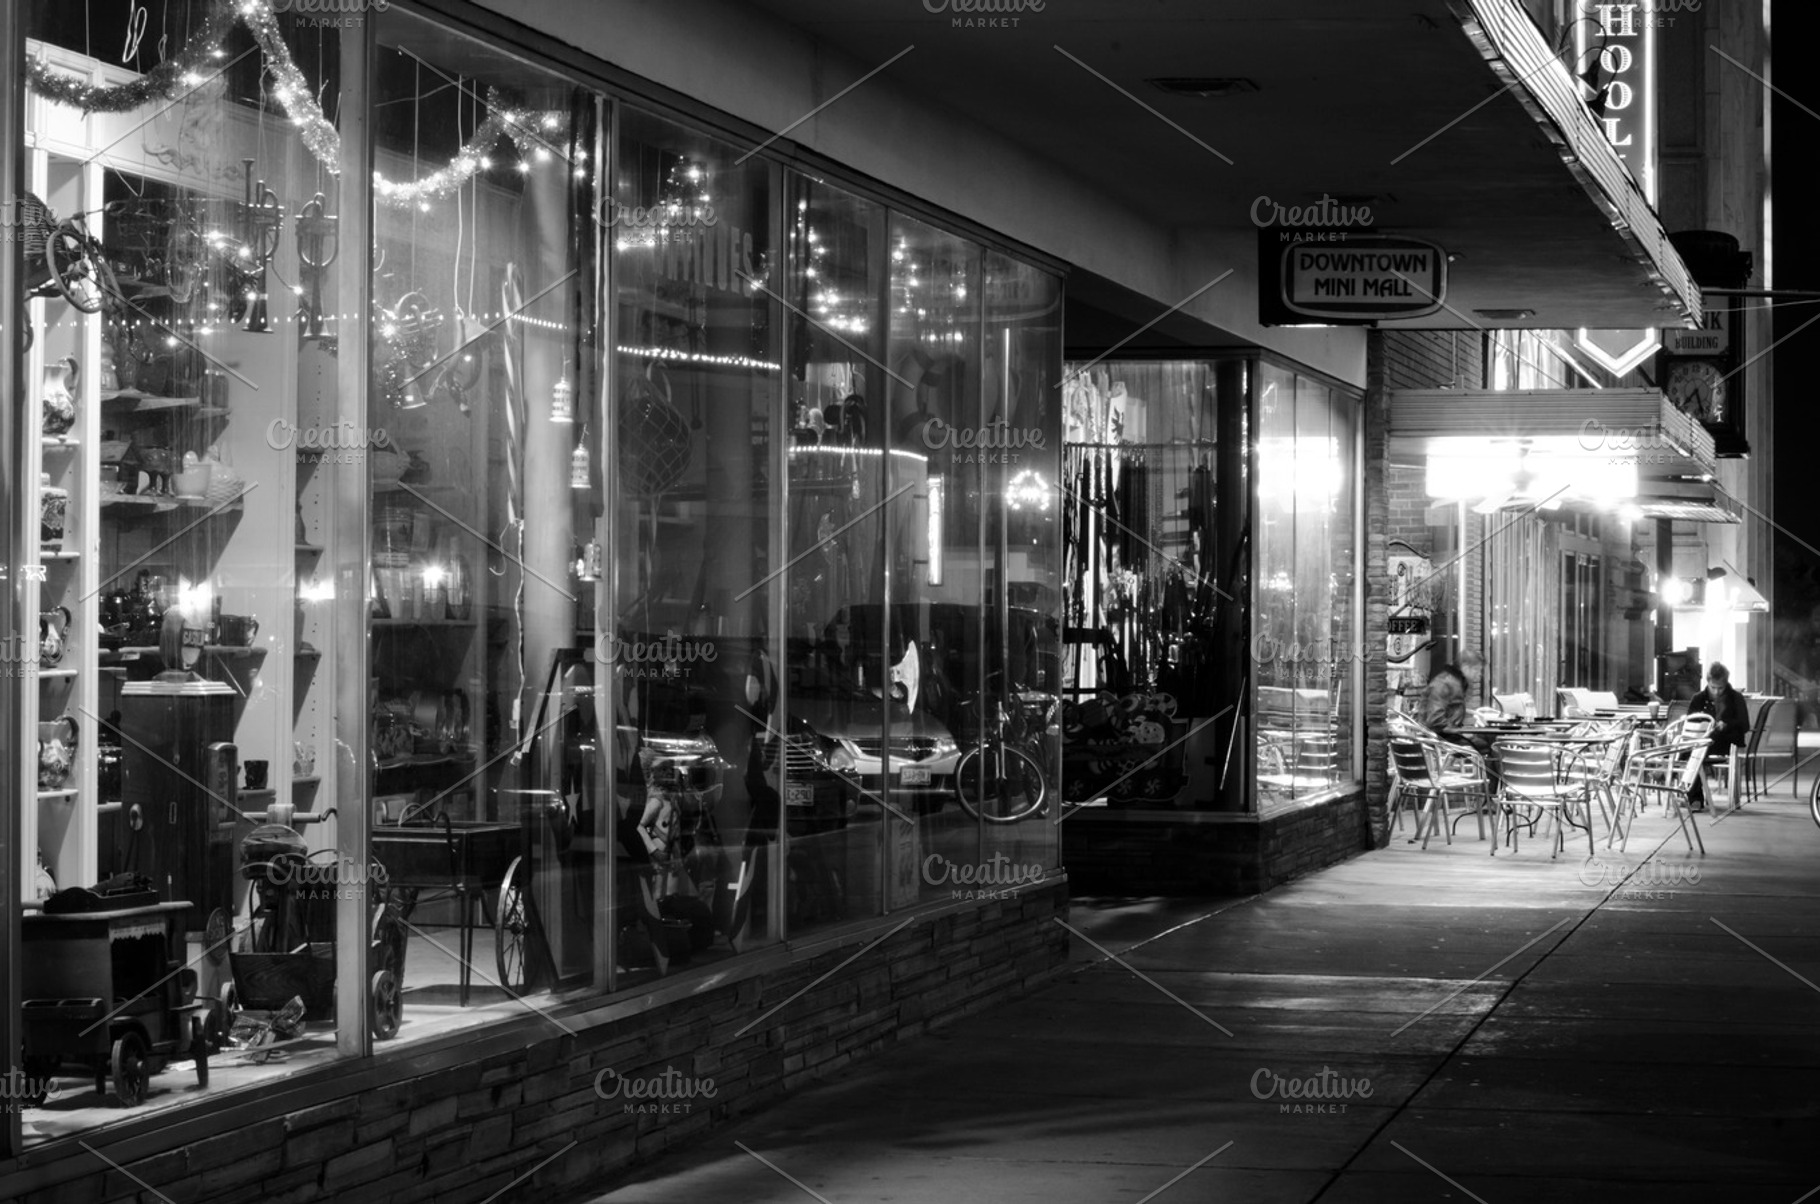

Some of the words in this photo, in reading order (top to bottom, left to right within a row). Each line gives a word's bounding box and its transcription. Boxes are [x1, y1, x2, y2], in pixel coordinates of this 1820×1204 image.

[1300, 253, 1427, 273] DOWNTOWN
[1314, 277, 1356, 298] MINI
[1362, 277, 1413, 298] MALL
[1675, 335, 1719, 350] BUILDING
